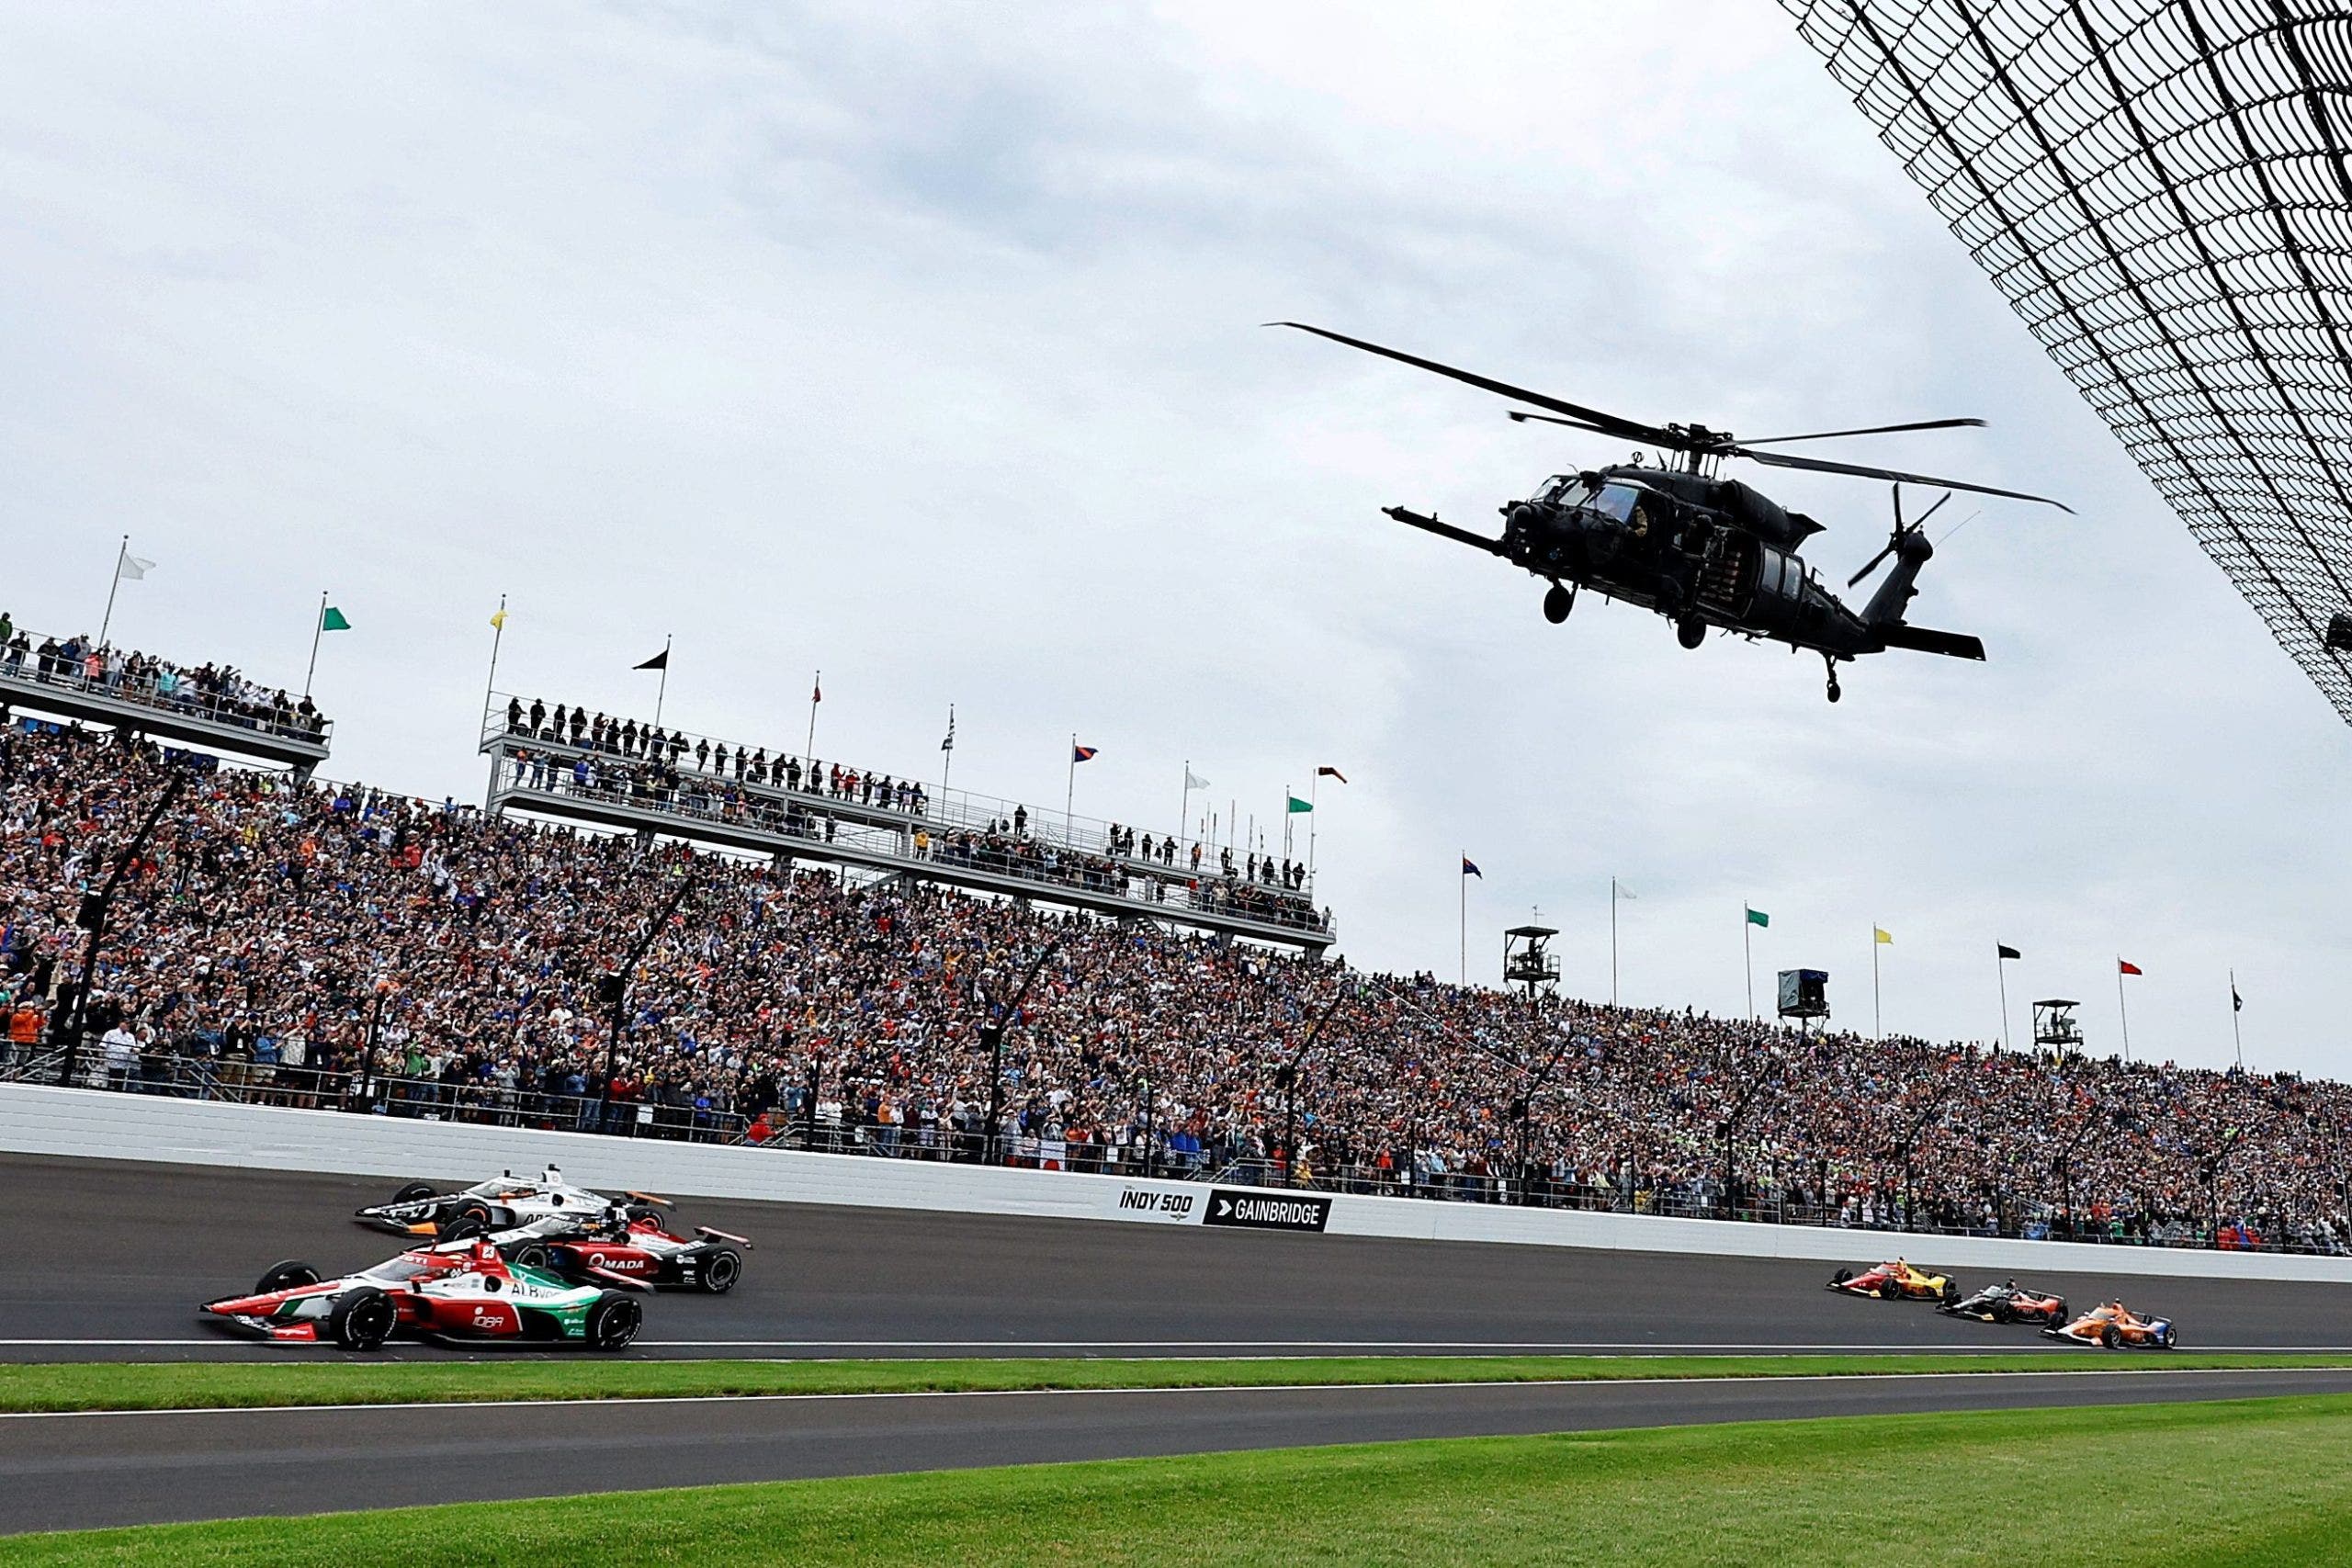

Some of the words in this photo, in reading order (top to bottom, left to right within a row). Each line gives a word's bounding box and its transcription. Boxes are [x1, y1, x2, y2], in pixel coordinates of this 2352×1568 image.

[1119, 1190, 1161, 1210] INDY
[1160, 1194, 1193, 1213] 500
[1235, 1199, 1320, 1224] GAINBRIDGE
